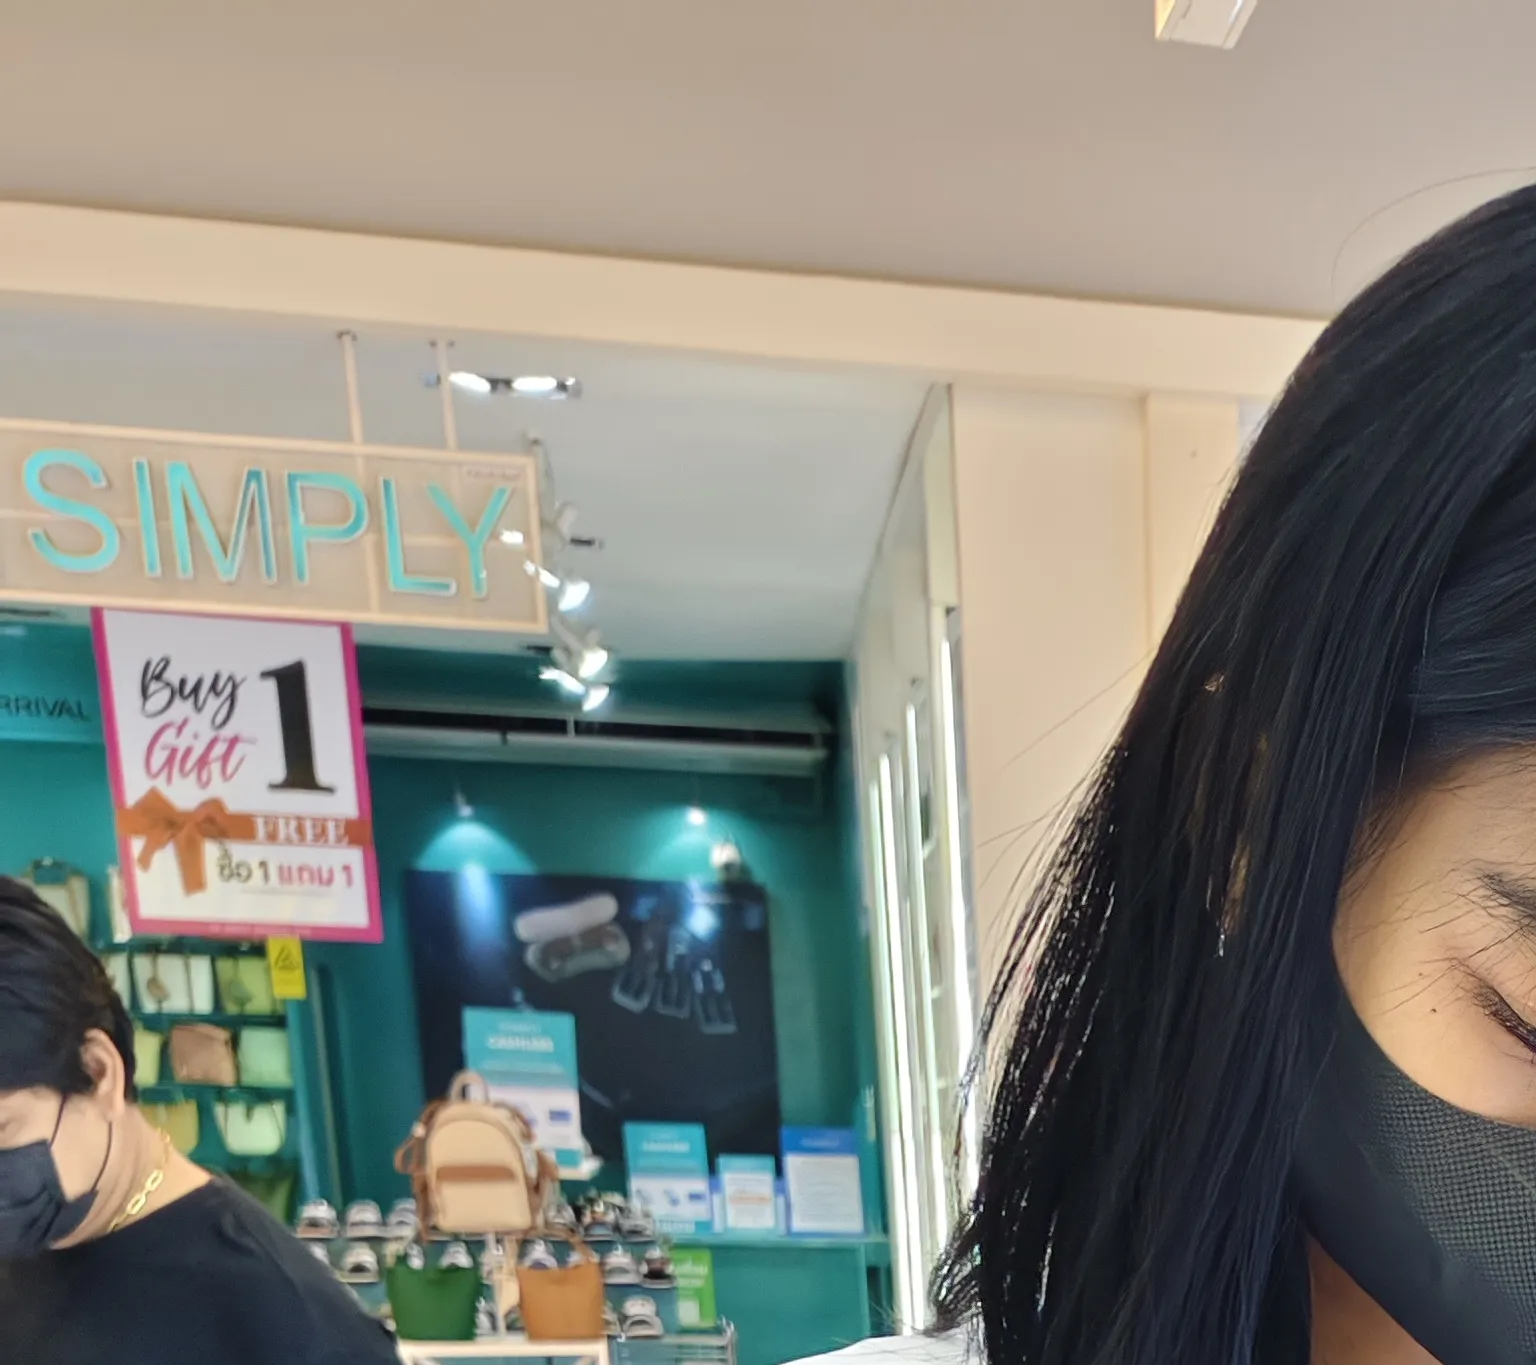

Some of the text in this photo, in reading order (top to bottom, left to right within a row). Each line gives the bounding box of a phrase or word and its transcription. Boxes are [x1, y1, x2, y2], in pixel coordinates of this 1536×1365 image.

[22, 448, 513, 598] SIMPLY
[139, 655, 247, 730] Buy
[260, 658, 337, 795] 1
[143, 716, 258, 790] Gift
[254, 814, 349, 846] FREE
[259, 860, 270, 884] 1
[341, 864, 354, 888] 1
